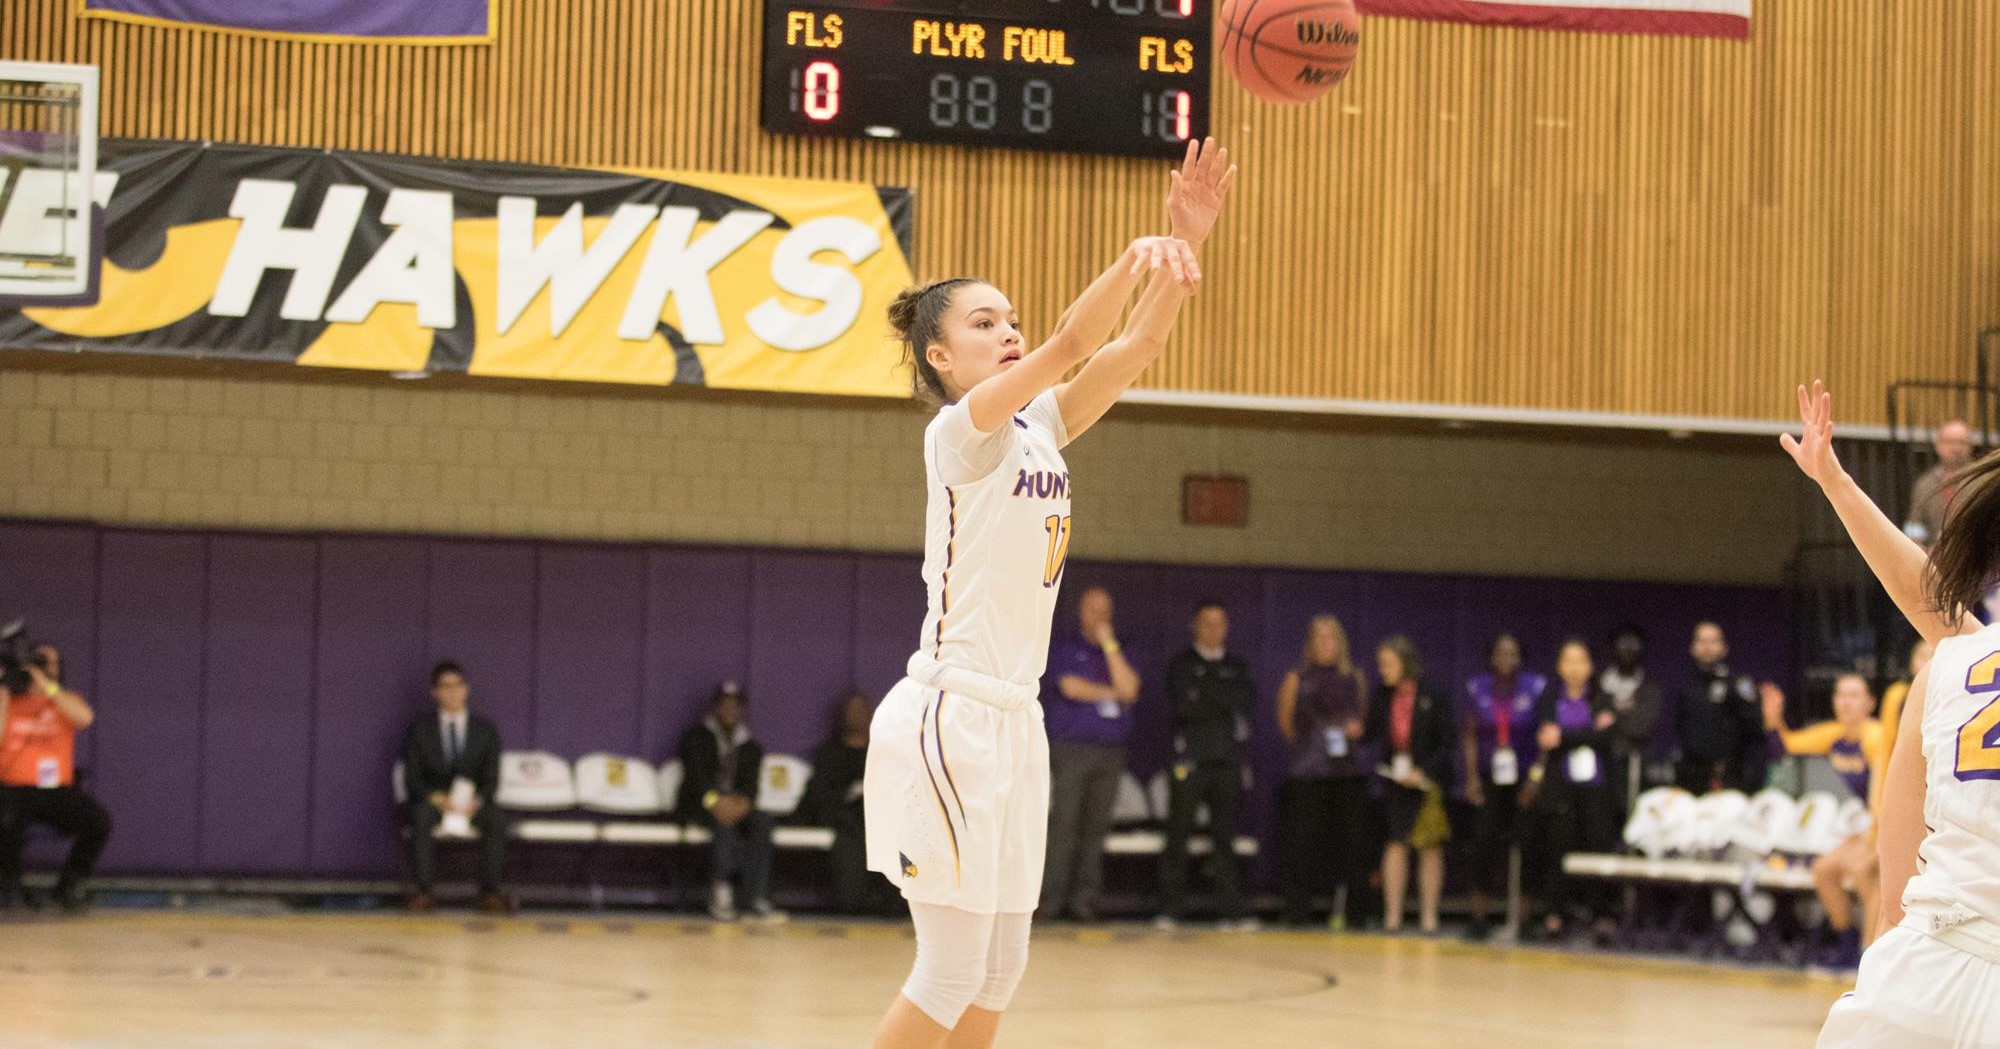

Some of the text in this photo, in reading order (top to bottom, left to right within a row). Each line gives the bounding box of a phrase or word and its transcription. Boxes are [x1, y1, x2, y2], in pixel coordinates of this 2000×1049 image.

[787, 10, 843, 48] FLS
[912, 19, 1075, 65] PLYR FOUL
[1297, 20, 1360, 45] Wilso
[1139, 36, 1194, 73] FLS
[207, 178, 881, 352] HAWKS
[1012, 468, 1071, 500] HUN
[1043, 514, 1071, 588] 11
